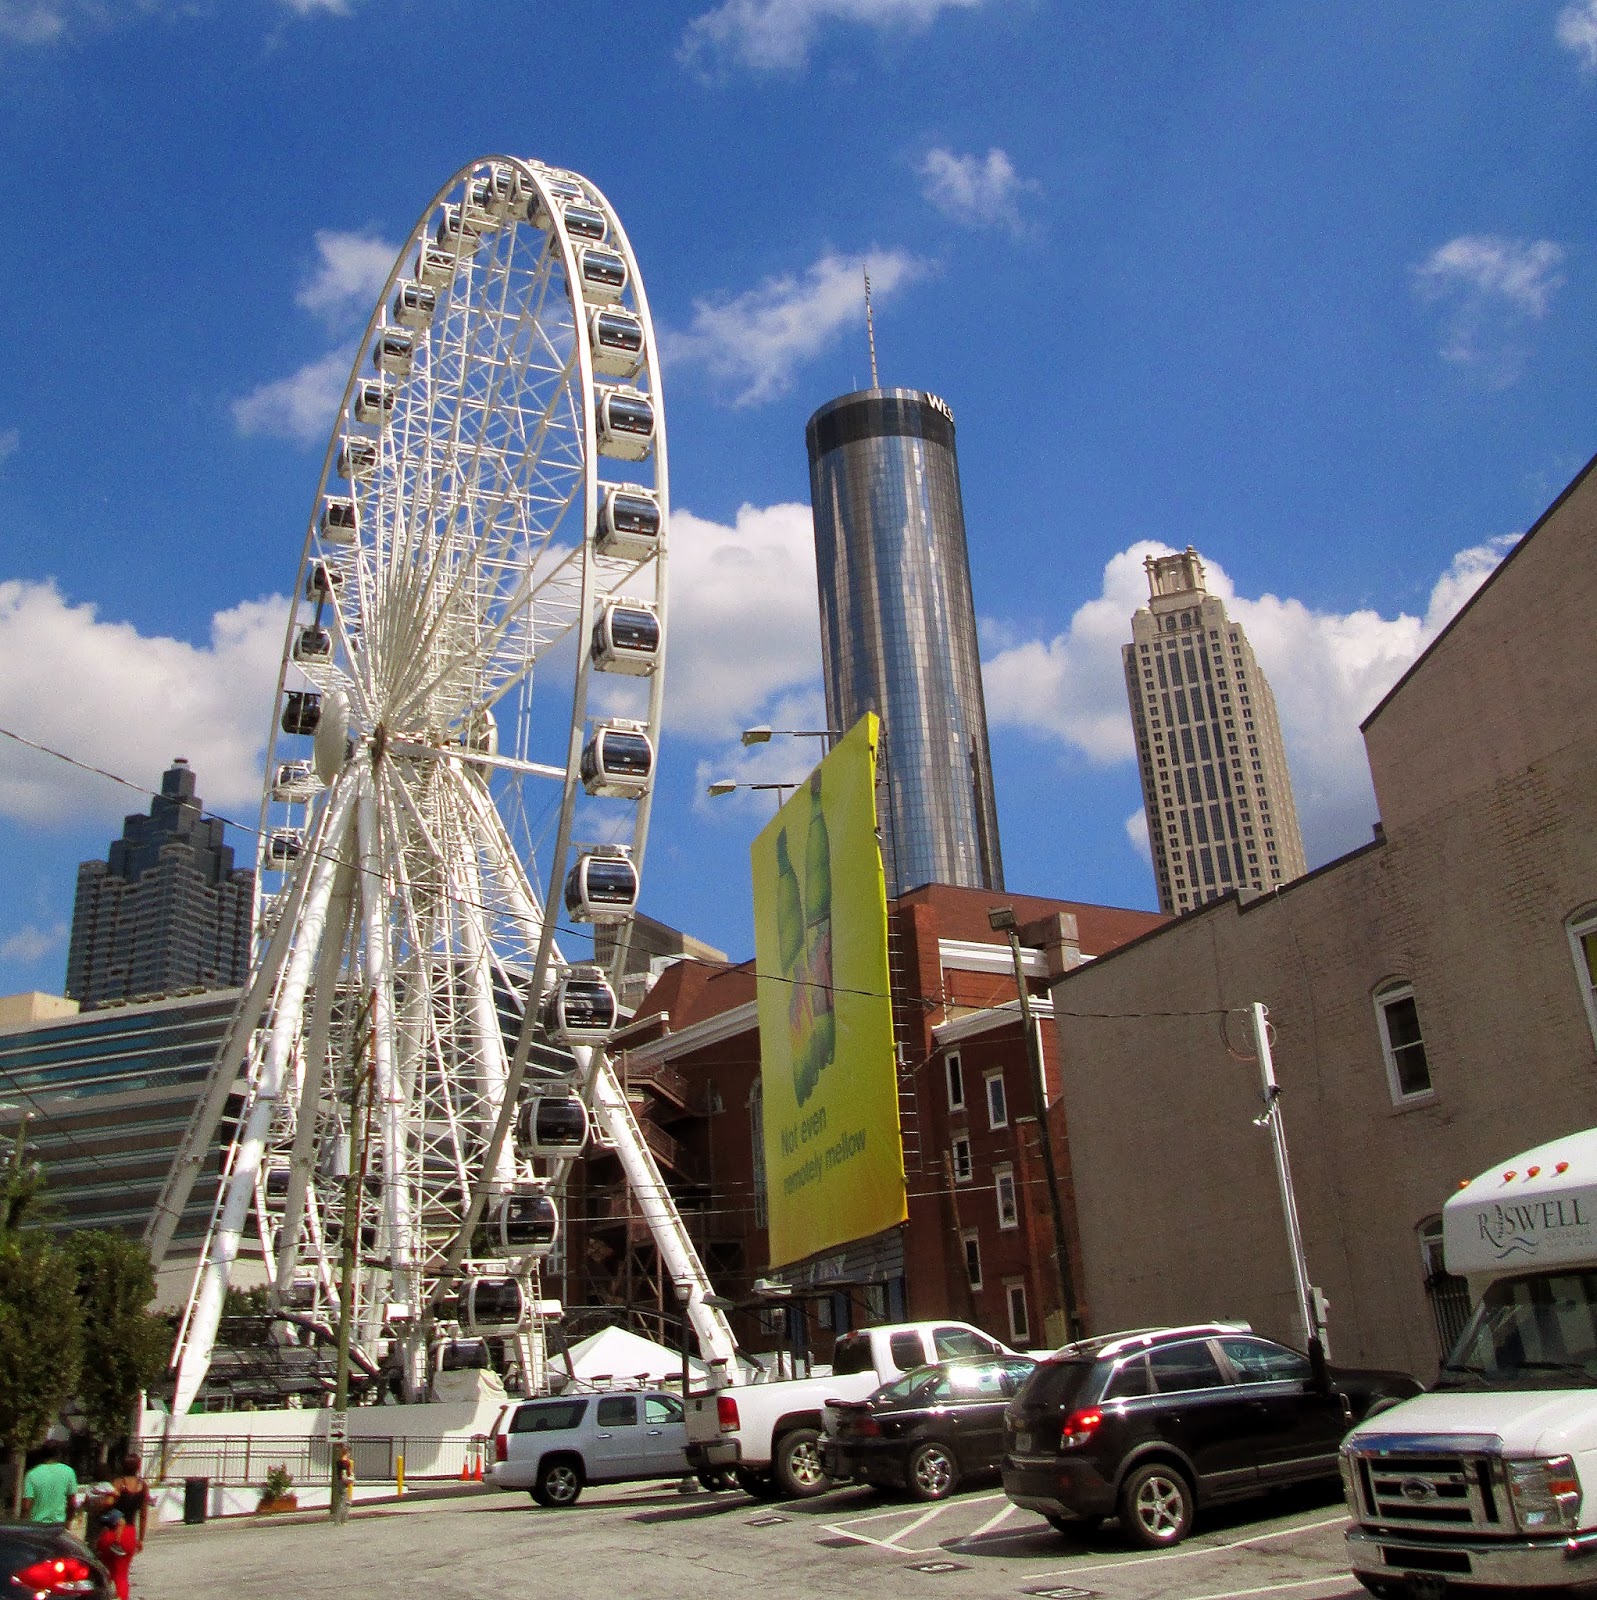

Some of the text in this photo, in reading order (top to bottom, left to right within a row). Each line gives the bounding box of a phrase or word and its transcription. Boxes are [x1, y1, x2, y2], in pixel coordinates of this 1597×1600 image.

[781, 1107, 827, 1157] Not even
[825, 1127, 866, 1170] mellow
[331, 1413, 347, 1421] ONE
